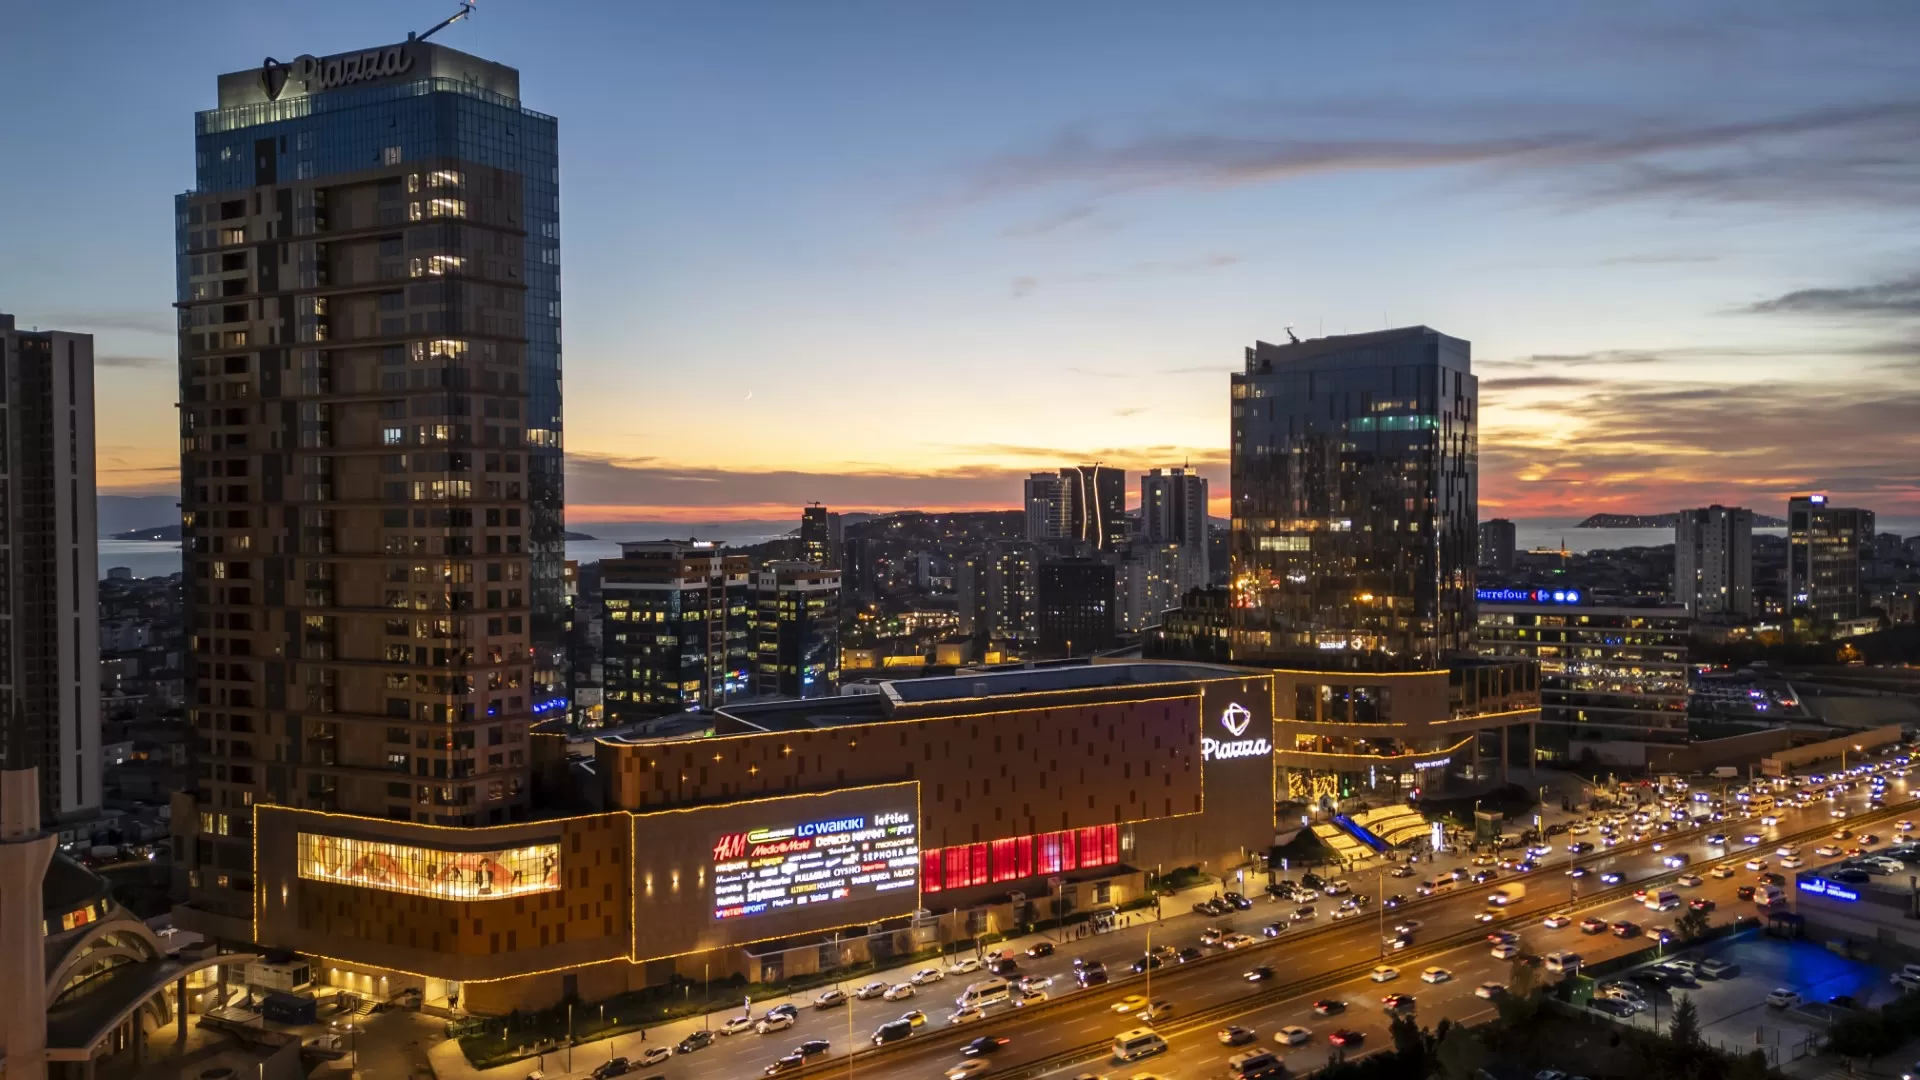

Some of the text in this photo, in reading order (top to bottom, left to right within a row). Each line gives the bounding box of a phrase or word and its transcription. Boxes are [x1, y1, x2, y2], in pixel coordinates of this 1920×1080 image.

[289, 48, 415, 92] Piazza
[1201, 738, 1272, 761] Piazza
[874, 812, 909, 826] lefties
[798, 824, 814, 837] LC
[713, 833, 747, 861] H&M
[862, 848, 904, 862] SEPHORA
[833, 865, 861, 877] OYSHO
[722, 903, 767, 917] INTERSPORT
